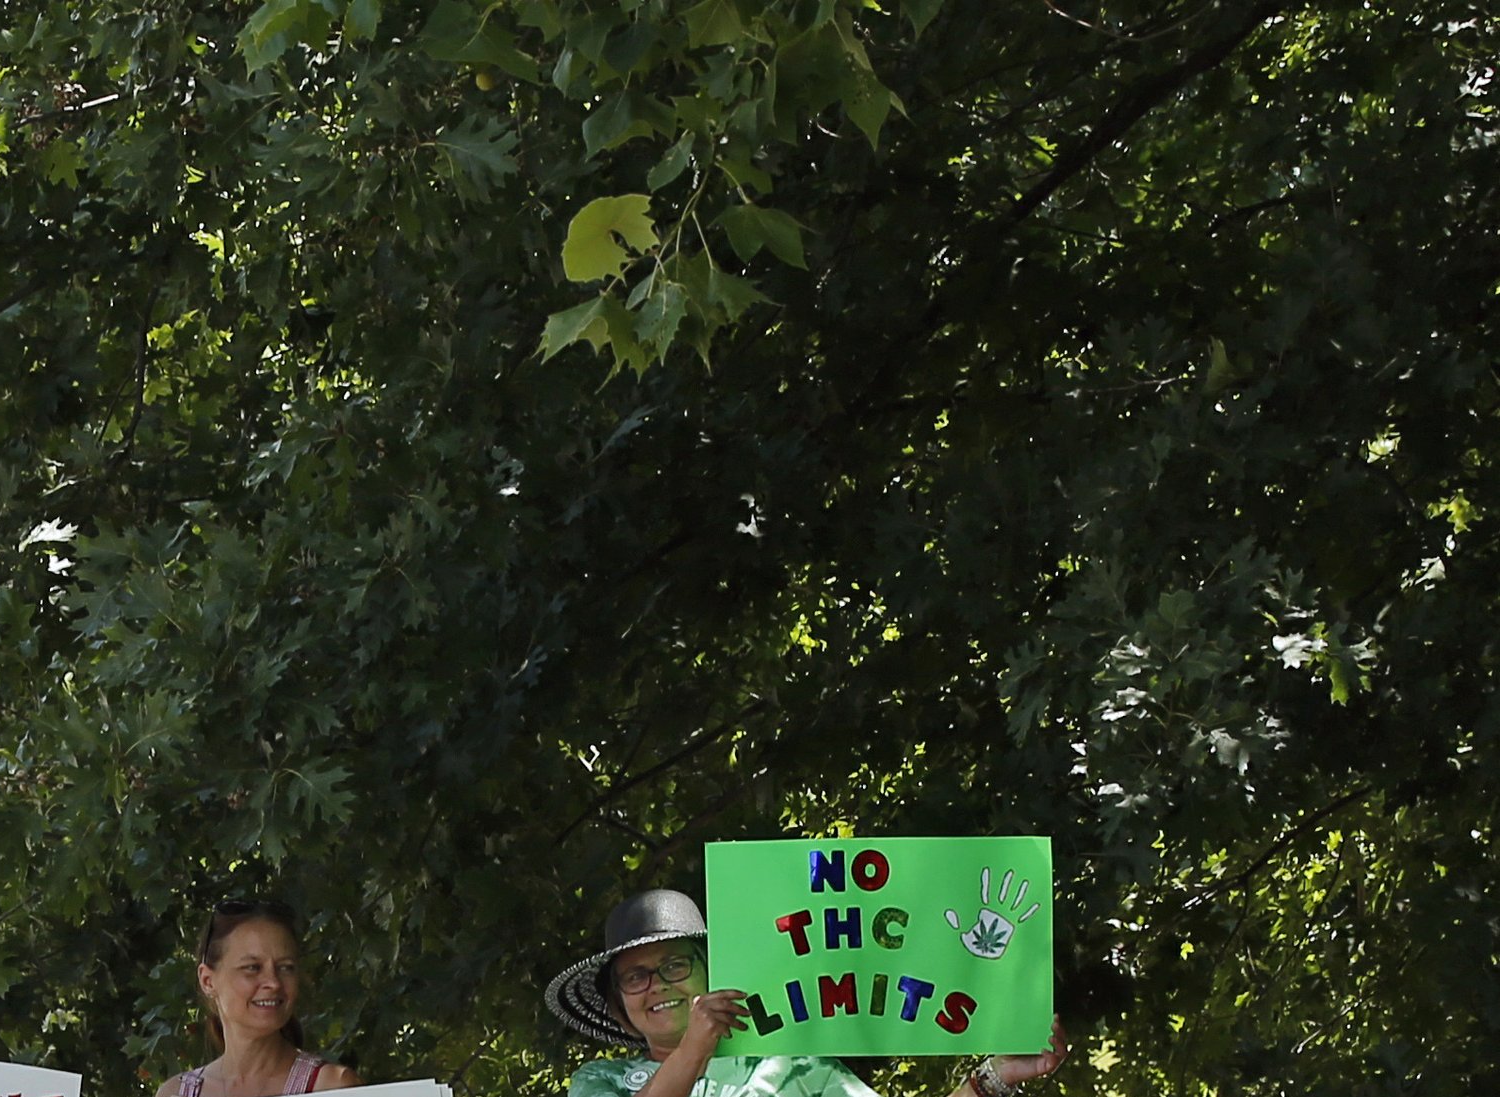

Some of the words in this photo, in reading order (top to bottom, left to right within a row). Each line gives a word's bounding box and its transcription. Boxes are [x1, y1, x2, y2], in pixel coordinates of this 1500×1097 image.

[808, 849, 891, 893] NO
[774, 906, 910, 956] THC
[745, 972, 978, 1037] LIMITS
